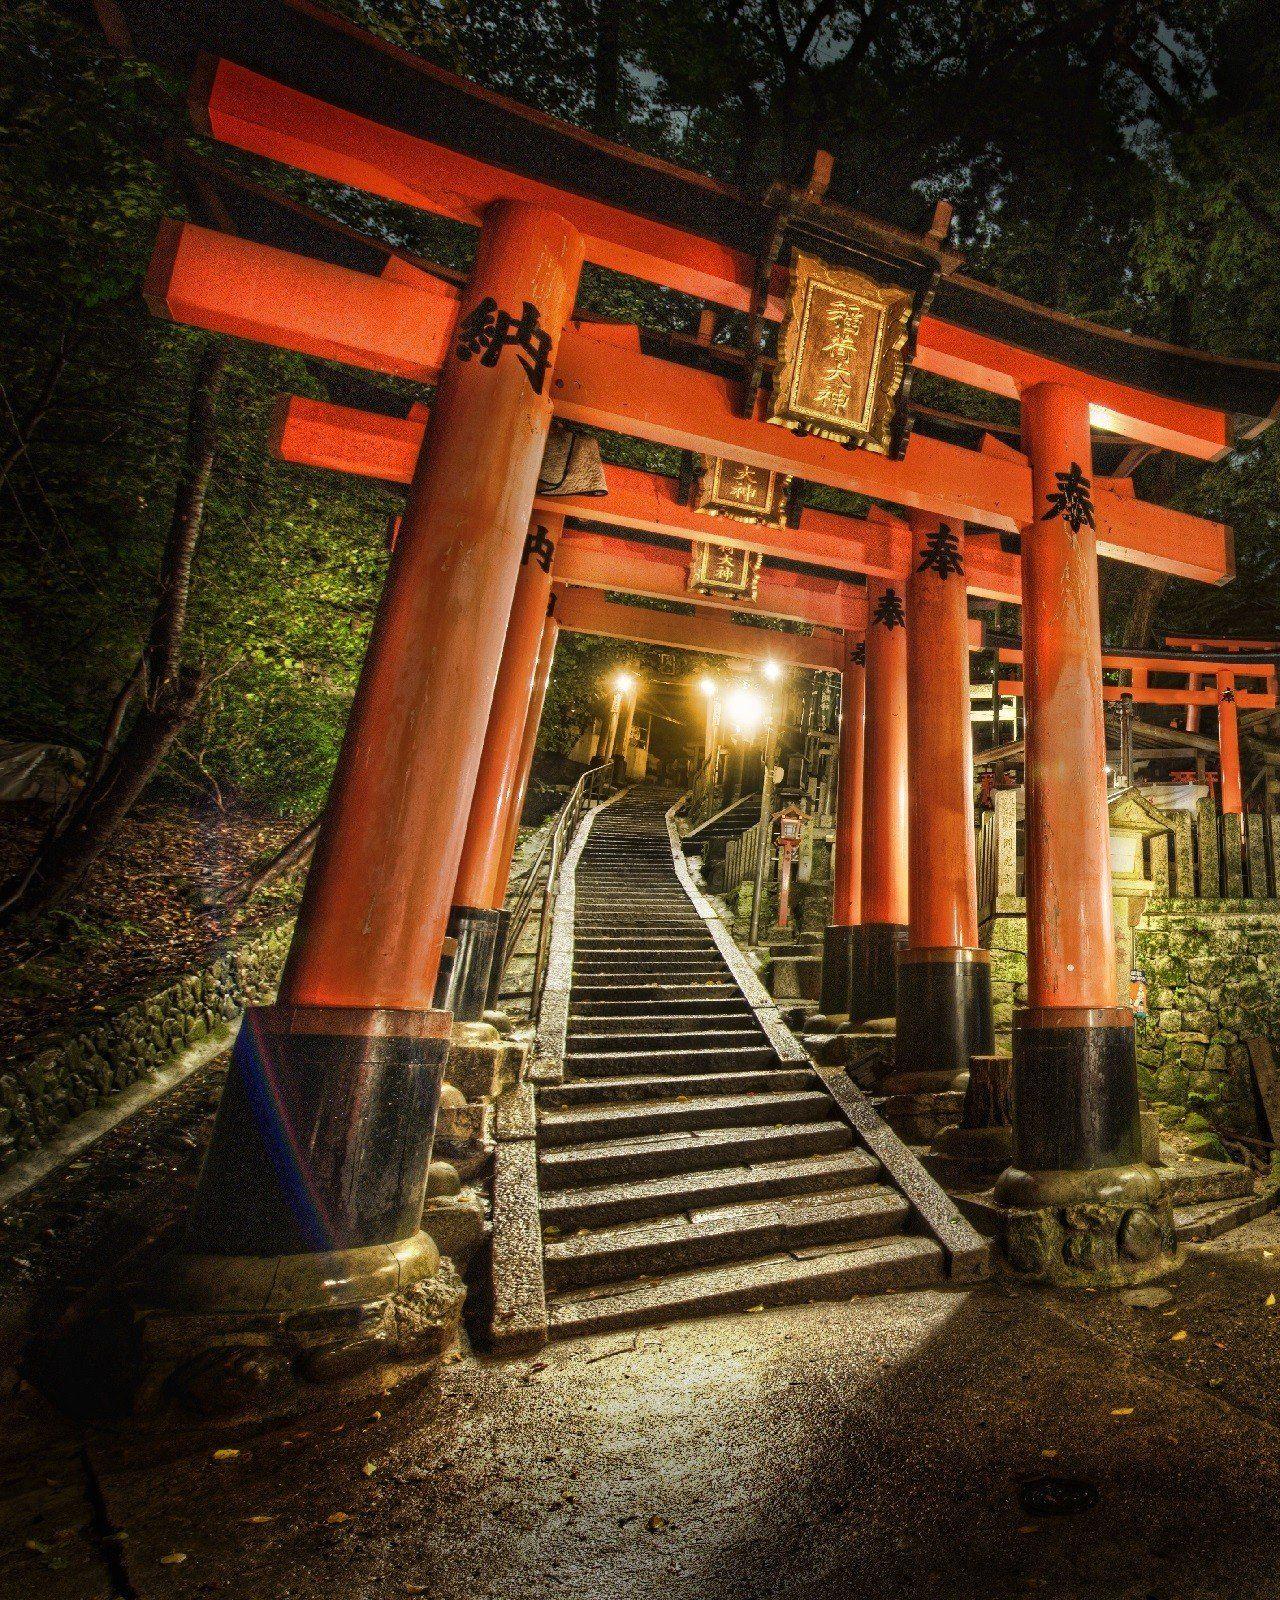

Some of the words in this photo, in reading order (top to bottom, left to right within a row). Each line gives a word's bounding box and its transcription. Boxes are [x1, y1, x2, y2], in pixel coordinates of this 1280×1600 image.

[456, 297, 552, 395] 納
[1041, 462, 1096, 533] 奉
[916, 523, 965, 581] 奉
[872, 588, 906, 631] 奉
